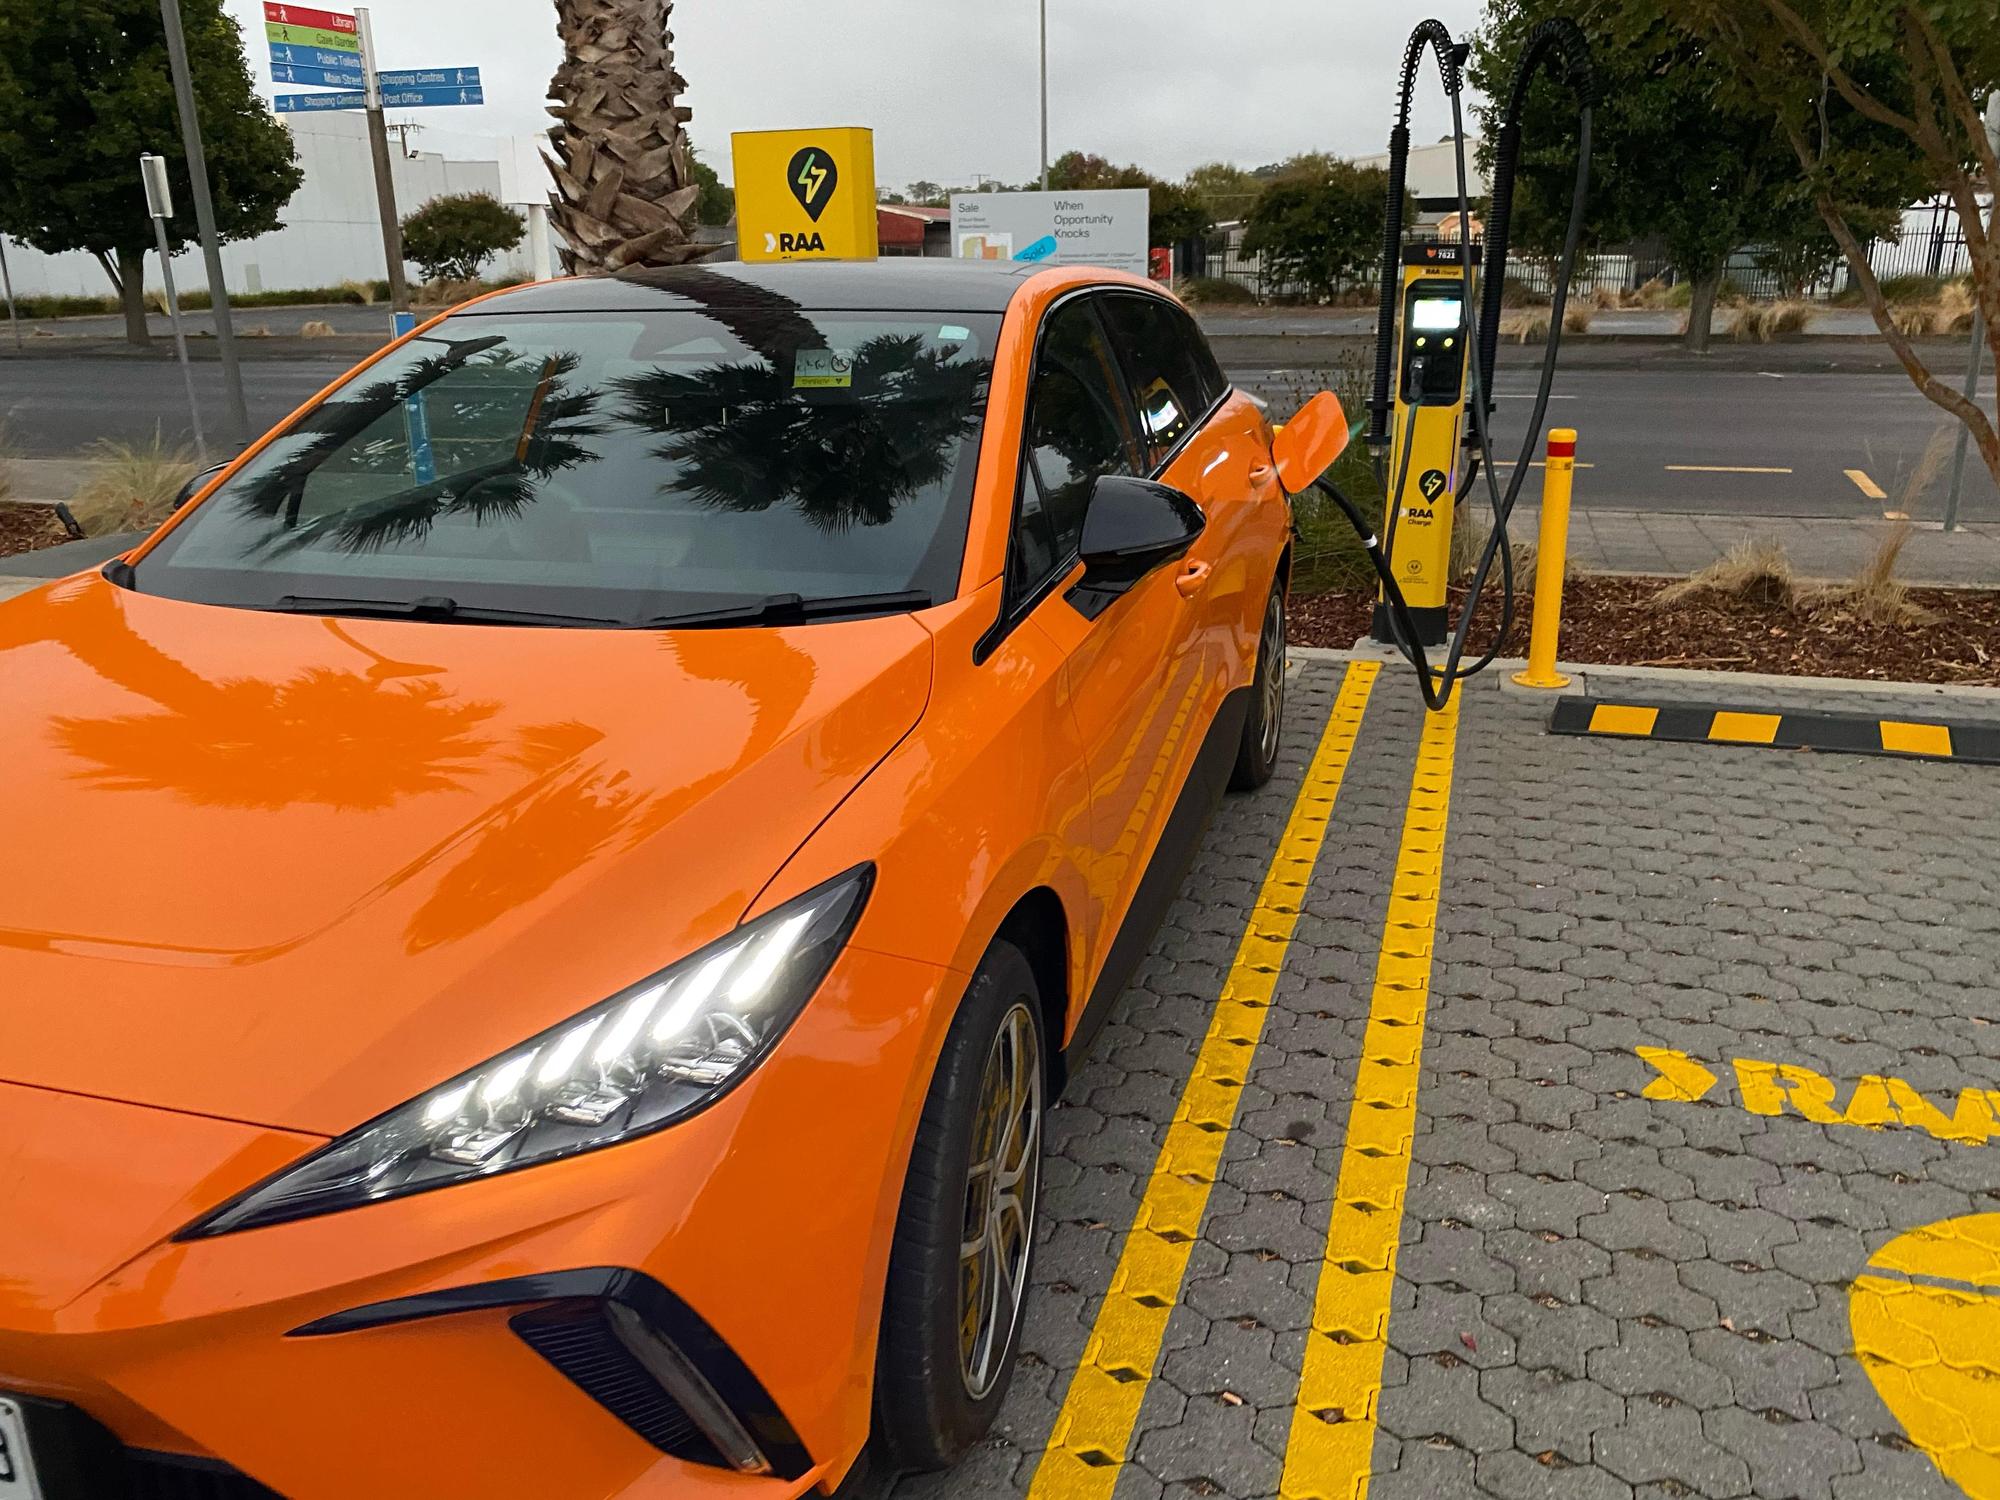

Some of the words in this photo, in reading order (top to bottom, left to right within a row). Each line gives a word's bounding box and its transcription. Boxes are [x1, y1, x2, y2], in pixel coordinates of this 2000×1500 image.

[332, 15, 354, 32] Library
[316, 33, 333, 45] Cave
[317, 52, 338, 65] Public
[324, 72, 341, 83] Main
[341, 74, 362, 86] Street
[381, 73, 415, 86] Shopping
[416, 72, 446, 83] Centres
[304, 95, 335, 107] Shopping
[336, 94, 362, 105] Centres
[384, 93, 400, 104] Post
[401, 92, 423, 103] Office
[958, 203, 980, 213] Sale
[1054, 201, 1084, 211] When
[1054, 213, 1113, 226] Opportunity
[1054, 229, 1090, 239] Knocks
[780, 232, 825, 252] RAA
[1023, 244, 1046, 263] Sold
[1409, 508, 1433, 518] RAA
[1408, 519, 1431, 527] Charge
